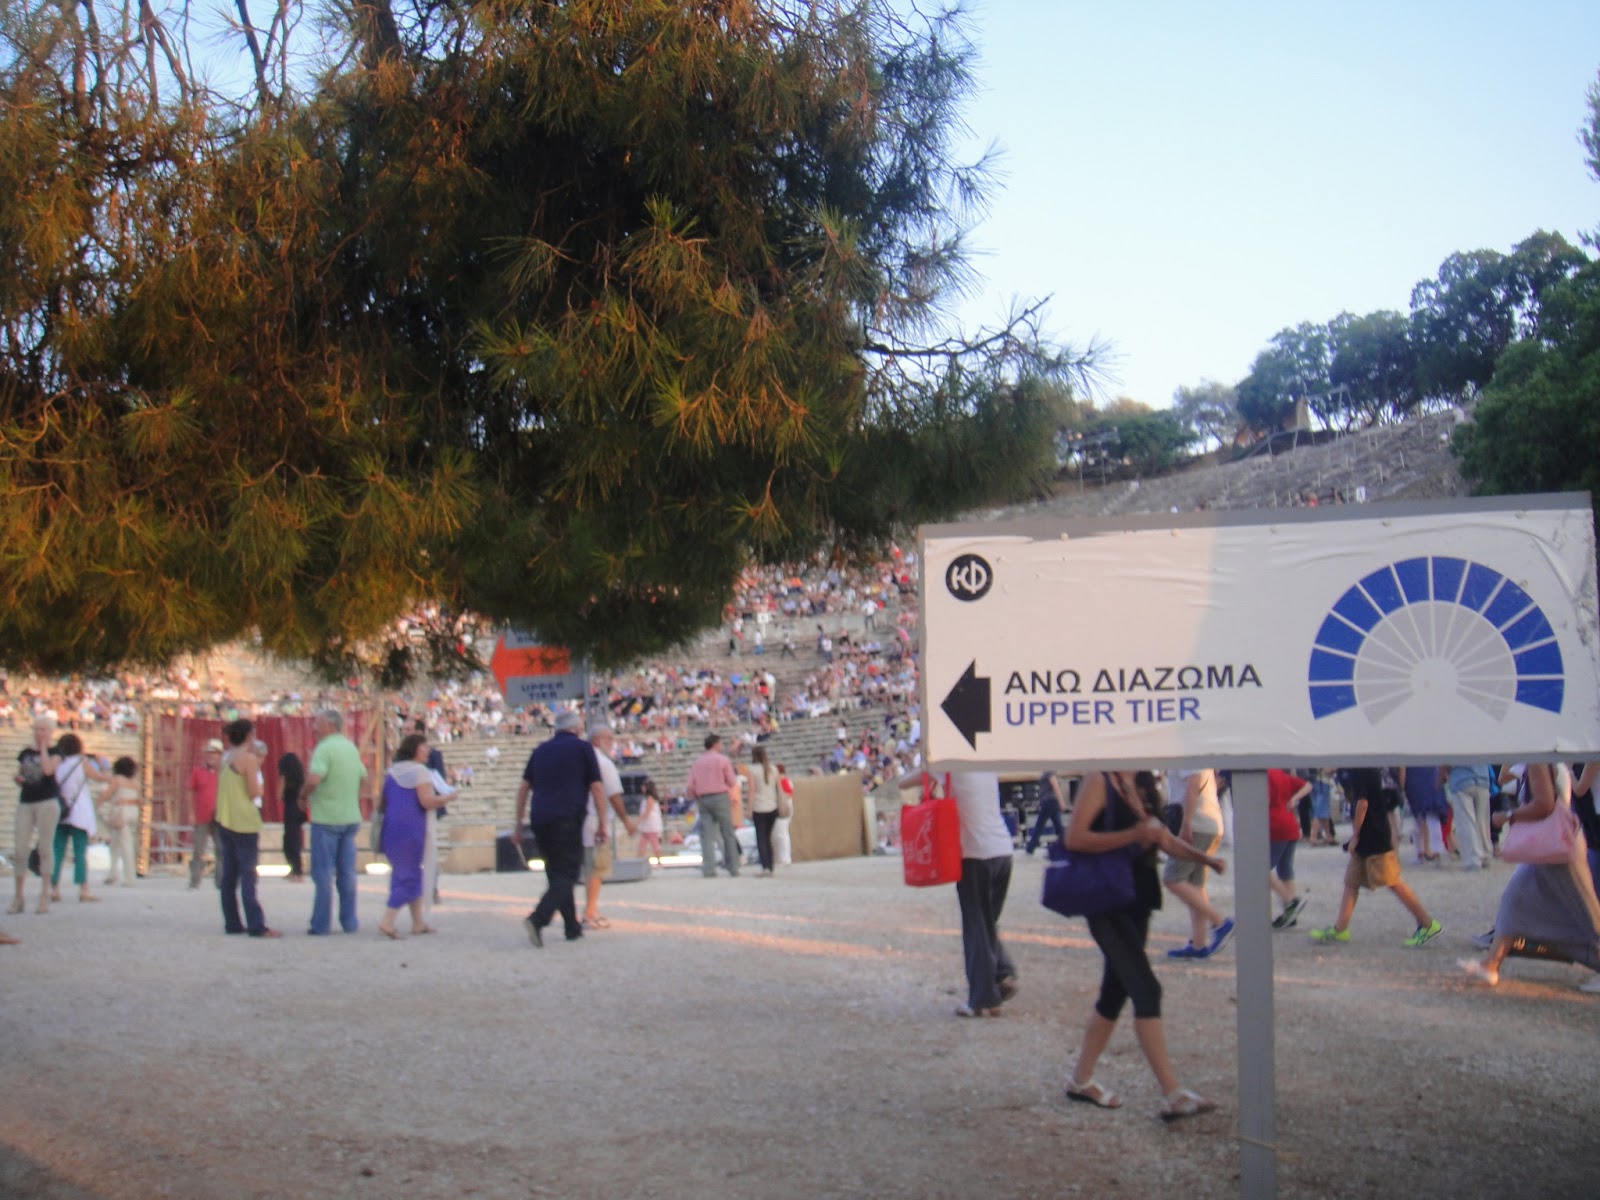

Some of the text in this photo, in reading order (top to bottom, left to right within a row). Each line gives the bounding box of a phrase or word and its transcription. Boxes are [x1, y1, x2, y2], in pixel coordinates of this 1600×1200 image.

[521, 682, 564, 692] UPPER
[1004, 664, 1263, 695] ΑΝΩ ΔΙΑΖΩΜΑ
[529, 692, 557, 701] TIER
[1005, 697, 1202, 726] UPPER TIER
